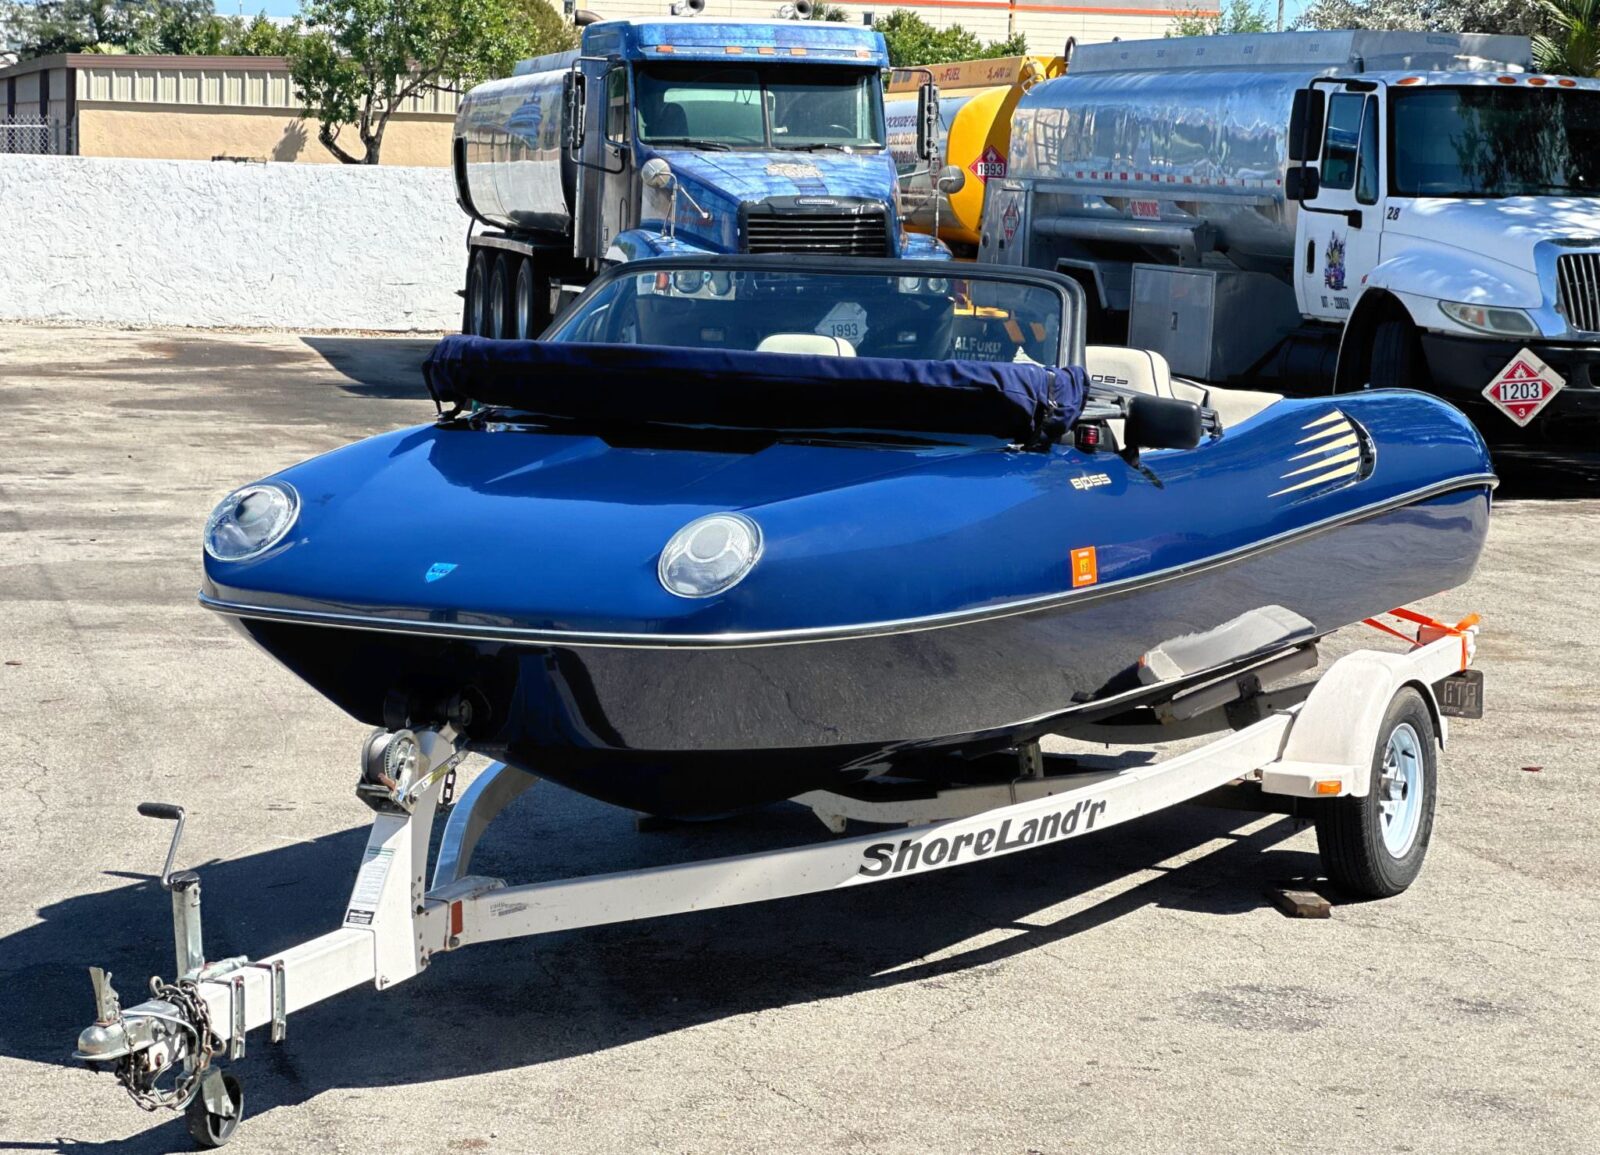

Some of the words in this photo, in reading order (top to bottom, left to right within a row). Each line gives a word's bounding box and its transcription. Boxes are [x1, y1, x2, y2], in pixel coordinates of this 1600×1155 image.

[979, 163, 1004, 176] 1993
[1386, 206, 1401, 221] 28
[831, 323, 858, 338] 1993
[1501, 383, 1539, 400] 1203
[1519, 408, 1525, 417] 3
[858, 798, 1107, 877] ShoreLand'r
